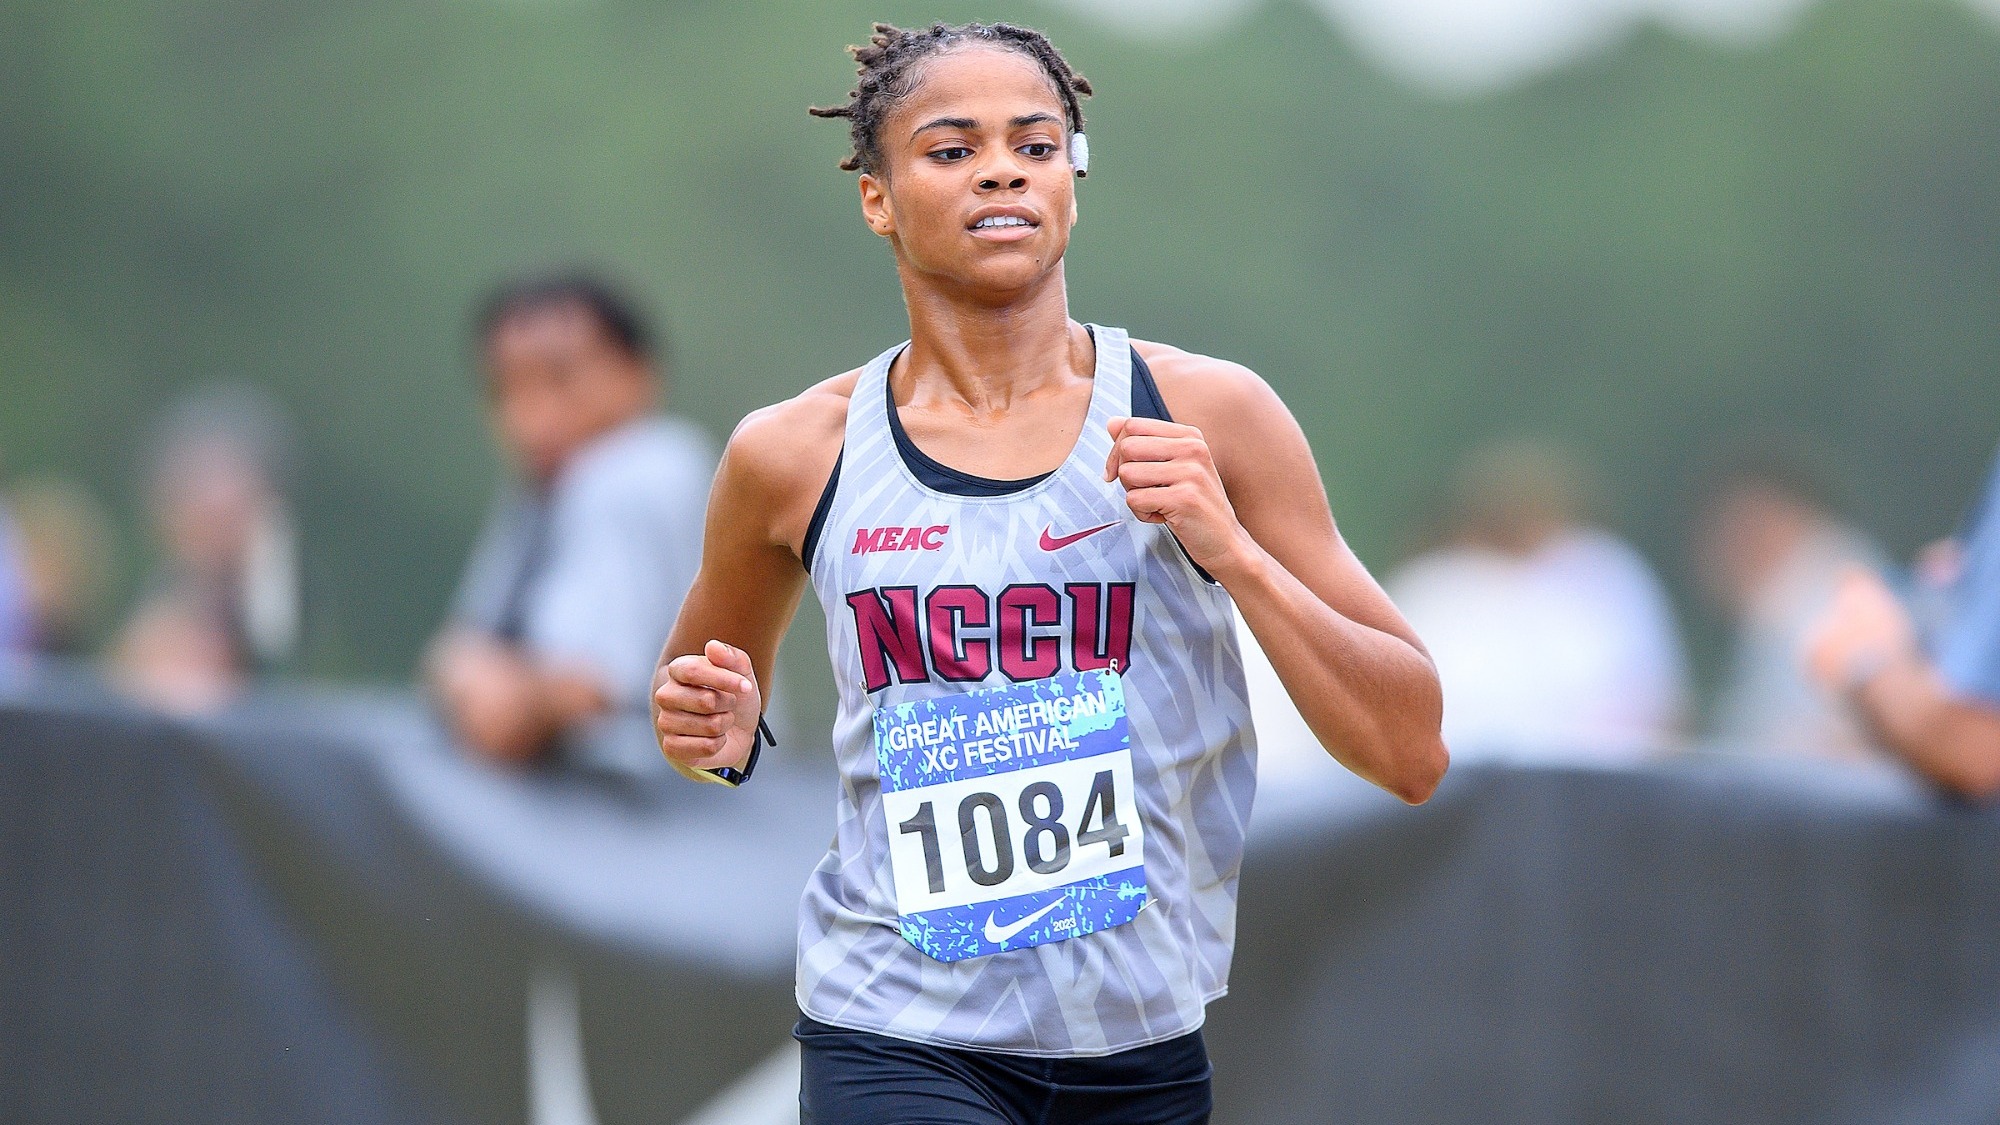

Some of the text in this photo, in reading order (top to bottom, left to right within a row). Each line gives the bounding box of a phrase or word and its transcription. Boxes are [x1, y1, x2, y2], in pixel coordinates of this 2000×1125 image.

[851, 525, 949, 556] MEAC
[845, 582, 1135, 694] NCCU
[888, 690, 1107, 752] GREAT AMERICAN
[923, 726, 1080, 774] XC FESTIVAL
[898, 769, 1130, 894] 1084
[1053, 917, 1077, 932] 2023
